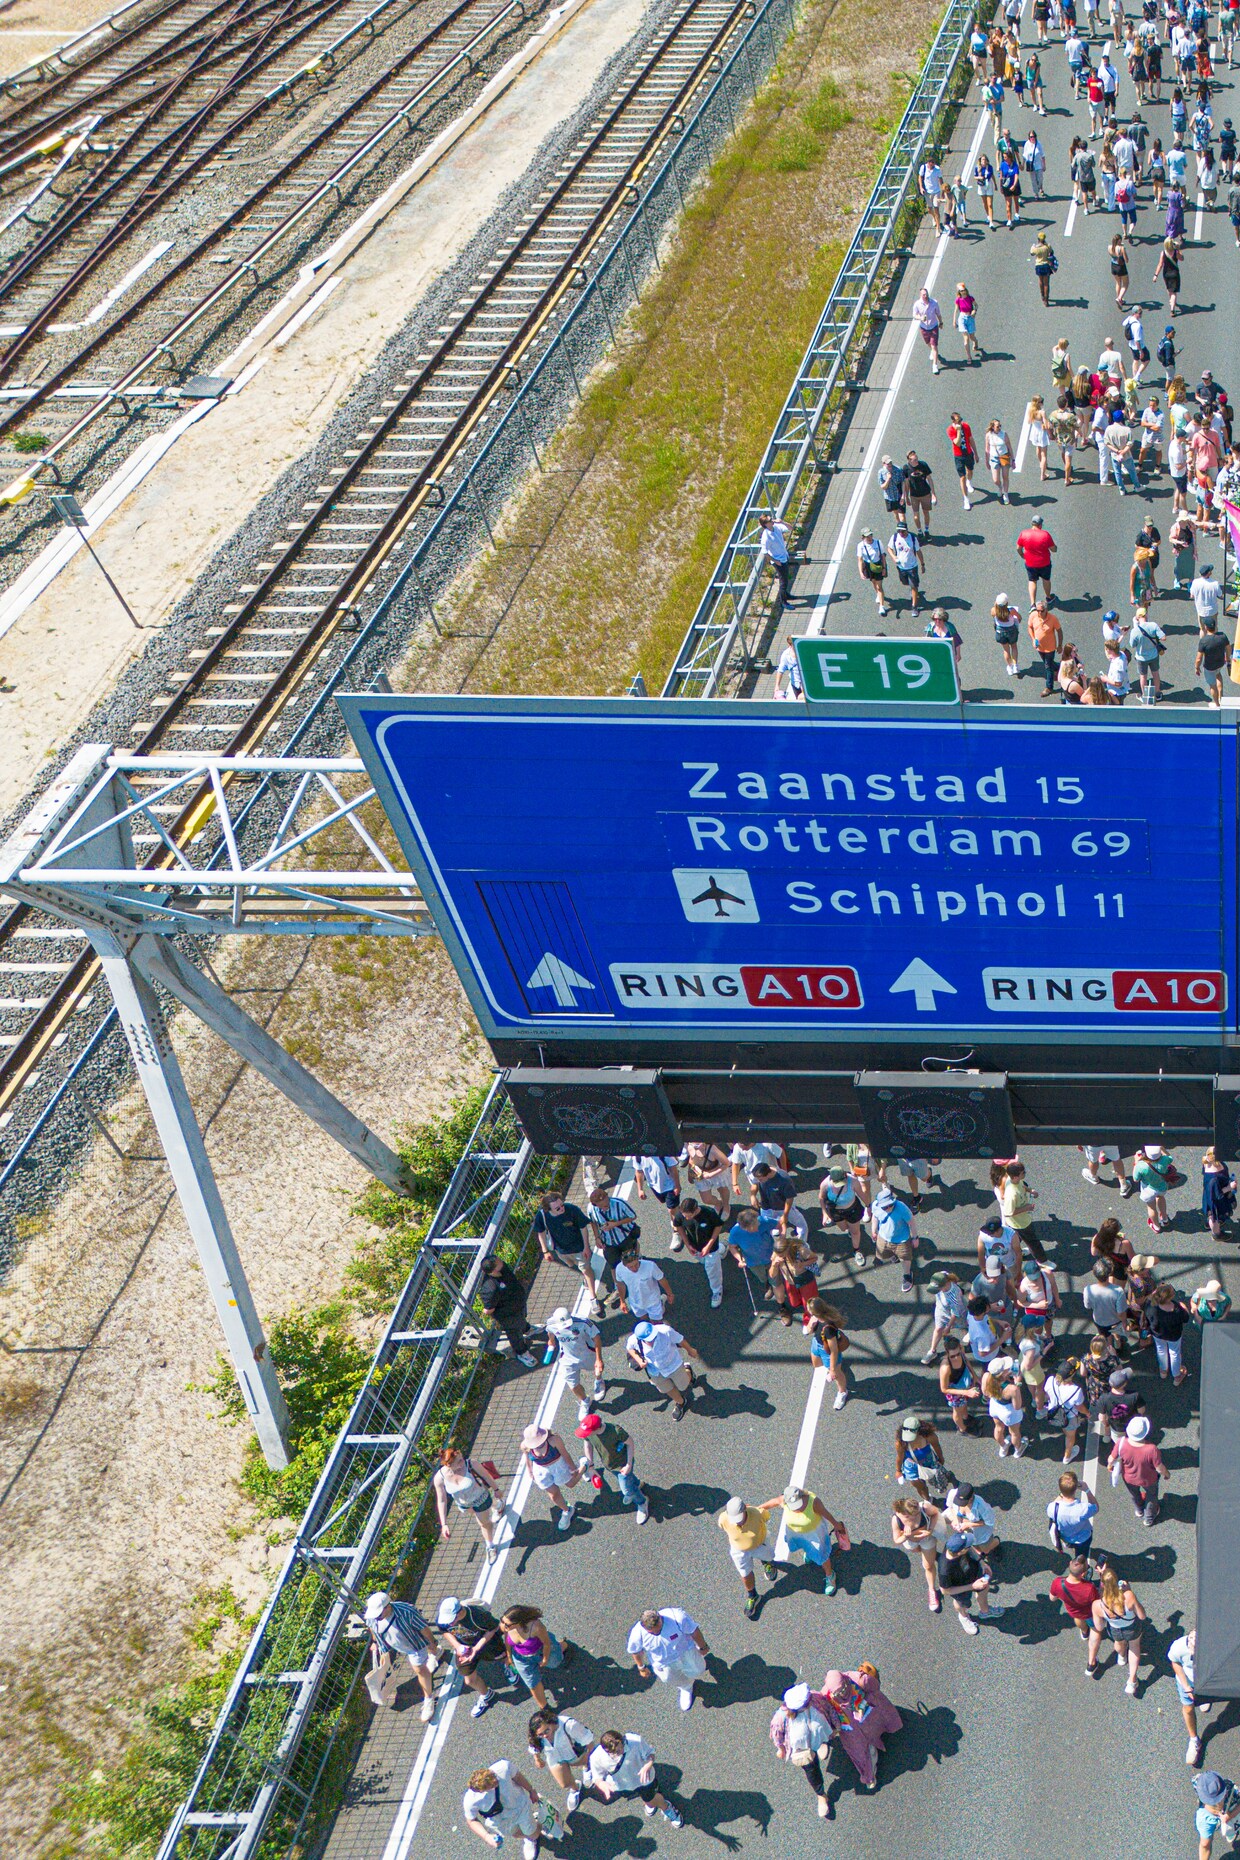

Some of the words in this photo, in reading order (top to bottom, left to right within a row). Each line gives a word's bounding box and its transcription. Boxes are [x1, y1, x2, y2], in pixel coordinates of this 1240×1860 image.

[817, 653, 854, 688] E
[873, 654, 931, 689] 19
[682, 762, 1008, 804] Zaanstad
[1035, 777, 1085, 805] 15
[687, 816, 1043, 857] Rotterdam
[1070, 831, 1131, 858] 69
[786, 881, 1067, 922] Schiphol
[1093, 893, 1125, 918] 11
[619, 974, 740, 997] RING
[756, 973, 851, 1000] A10
[992, 978, 1108, 1001] RING
[1123, 977, 1217, 1004] A10
